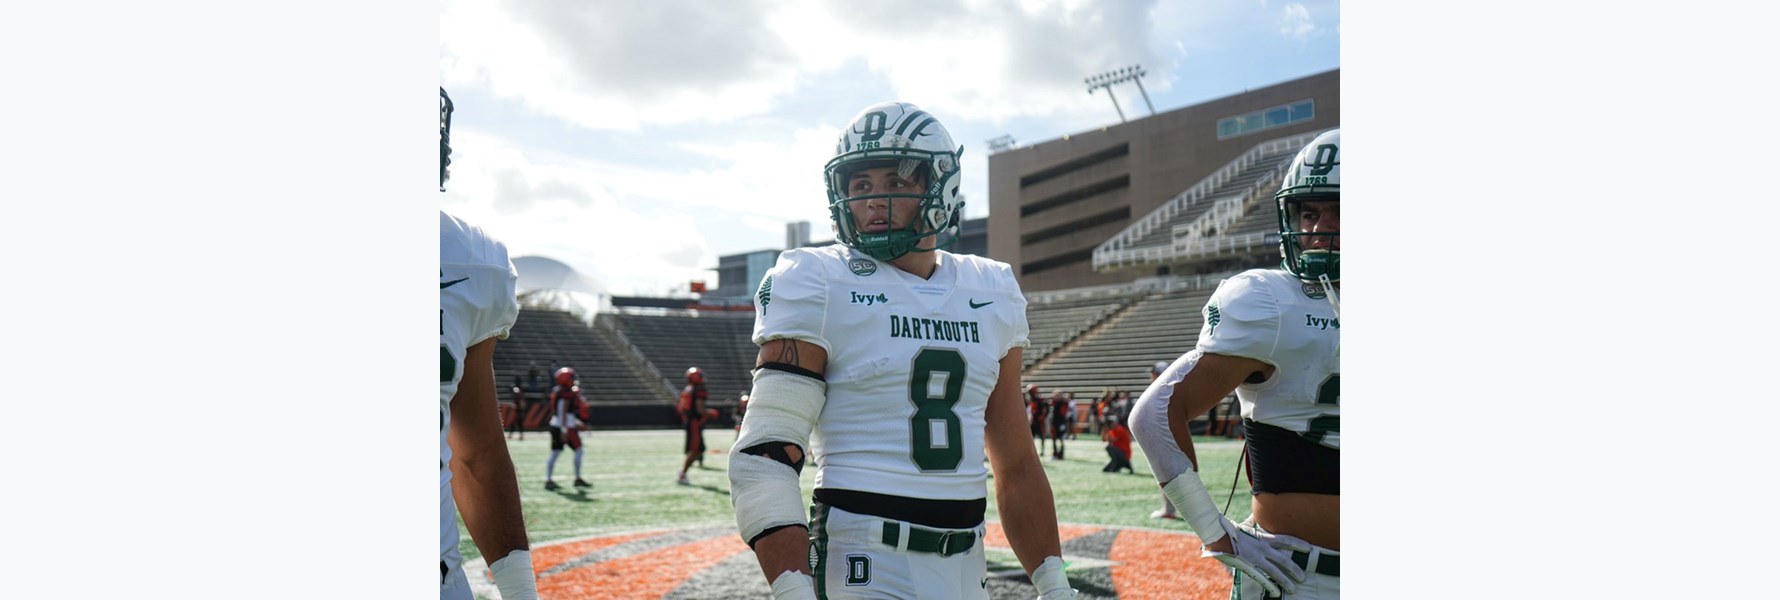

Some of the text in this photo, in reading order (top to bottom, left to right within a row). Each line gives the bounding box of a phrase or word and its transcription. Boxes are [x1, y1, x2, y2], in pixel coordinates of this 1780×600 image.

[861, 111, 887, 142] D
[1310, 144, 1338, 175] D
[1305, 176, 1328, 185] 1769
[850, 291, 875, 306] Ivy
[890, 314, 980, 343] DARTMOUTH
[1306, 314, 1329, 330] Ivy
[907, 346, 968, 473] 8
[845, 553, 872, 586] D
